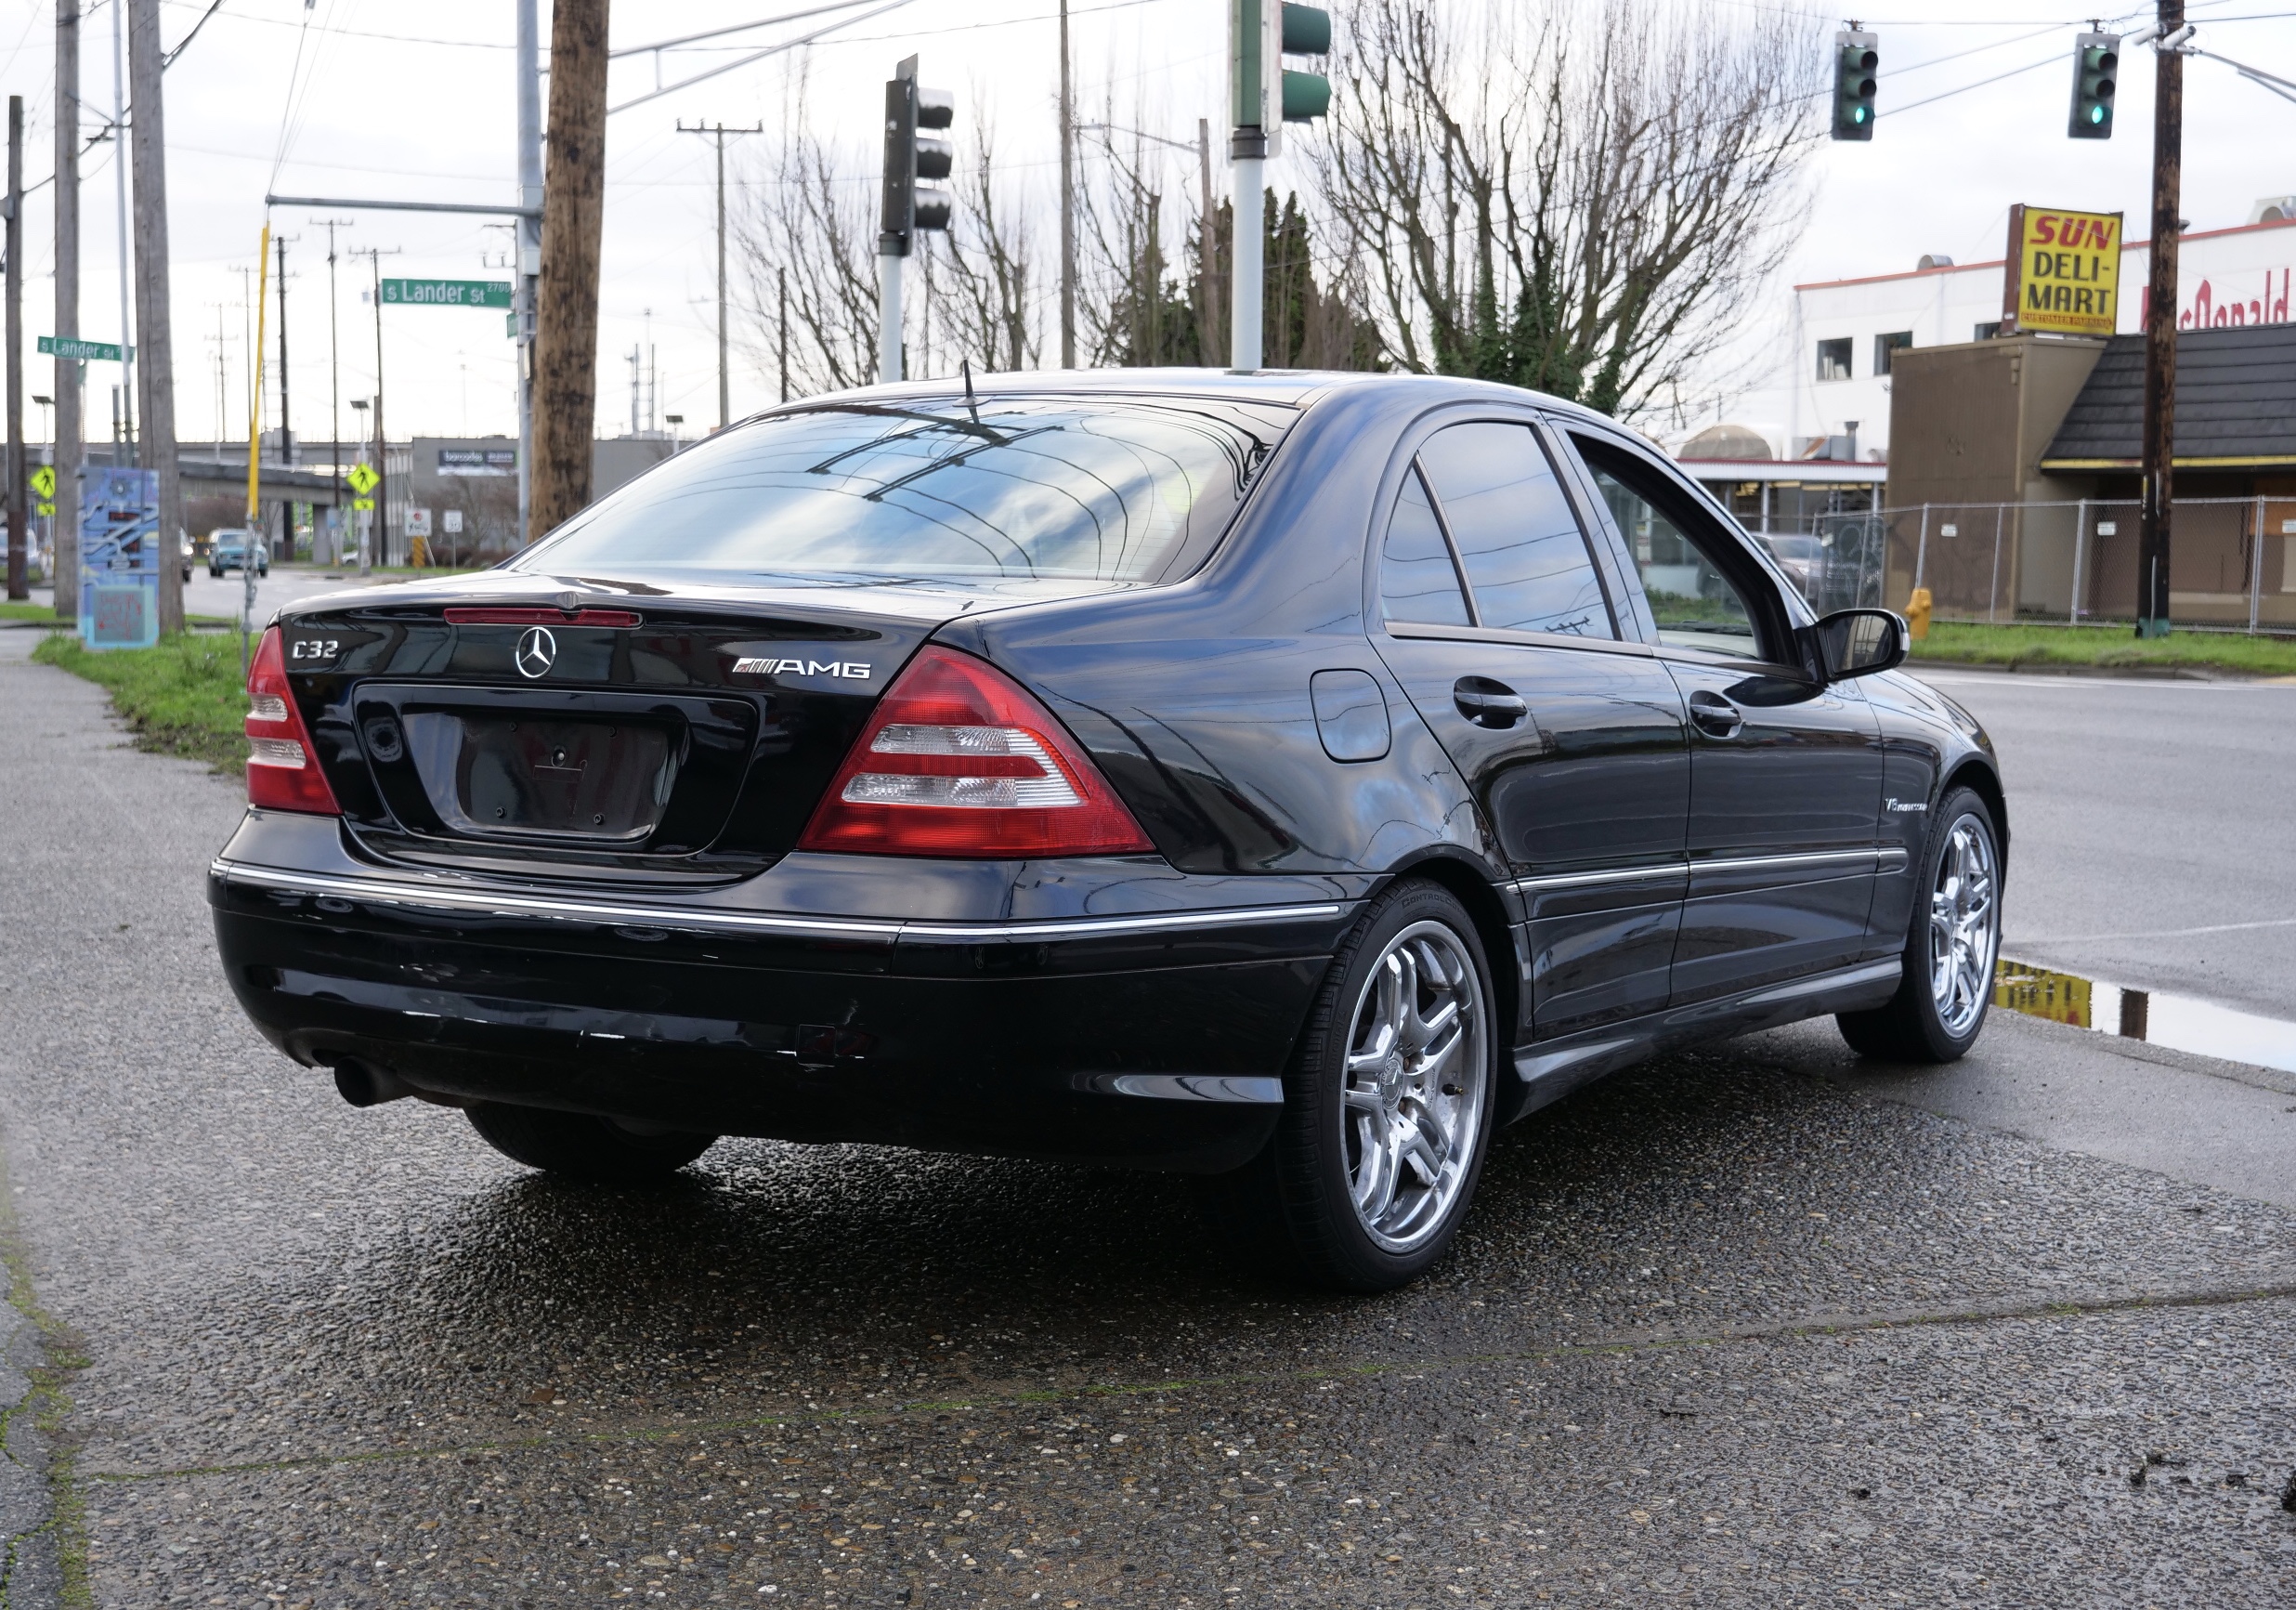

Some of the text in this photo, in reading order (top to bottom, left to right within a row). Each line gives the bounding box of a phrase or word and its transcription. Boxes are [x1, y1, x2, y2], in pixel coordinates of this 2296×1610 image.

[2029, 215, 2115, 251] SUN
[2033, 251, 2110, 282] DELI-
[401, 280, 464, 304] Lander
[2026, 283, 2111, 315] MART
[53, 337, 100, 359] Lander
[292, 640, 339, 660] C32
[774, 659, 871, 680] AMG
